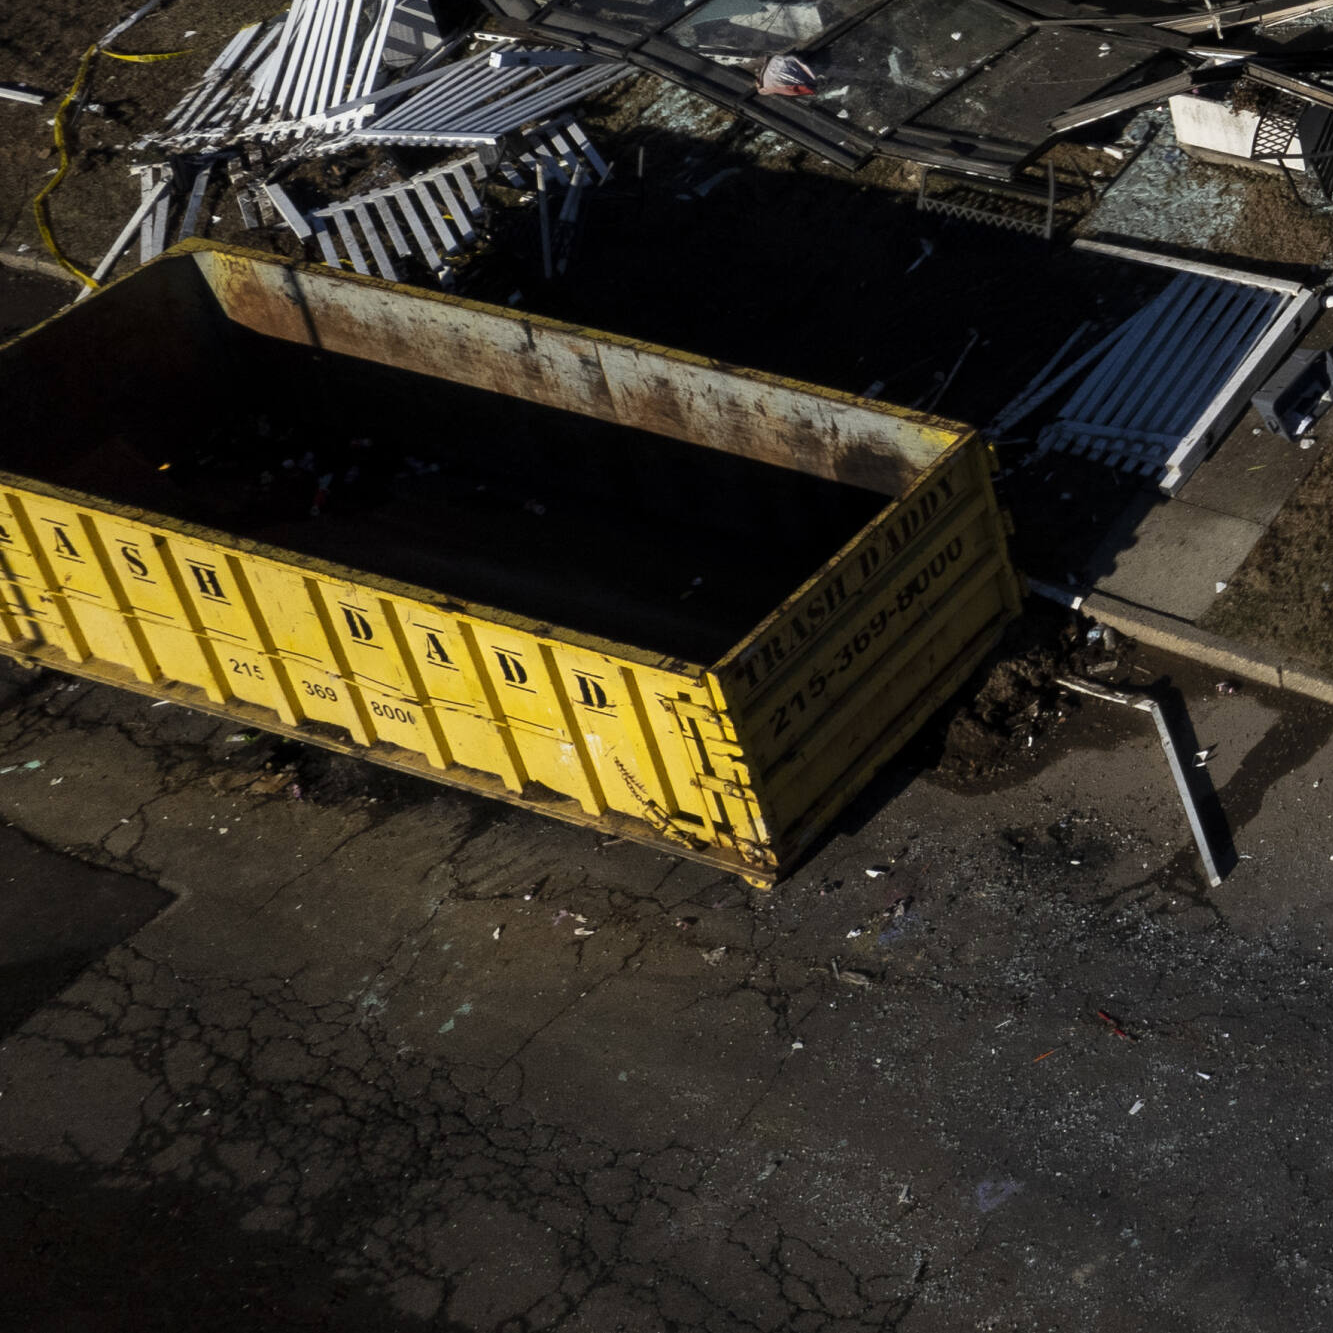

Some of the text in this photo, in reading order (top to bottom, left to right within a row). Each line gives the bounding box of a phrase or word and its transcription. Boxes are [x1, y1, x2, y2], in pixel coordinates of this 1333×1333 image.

[229, 658, 264, 681] 215
[302, 680, 338, 702] 369
[736, 474, 956, 688] TRASH DADDY
[769, 536, 963, 738] 215-369-8000
